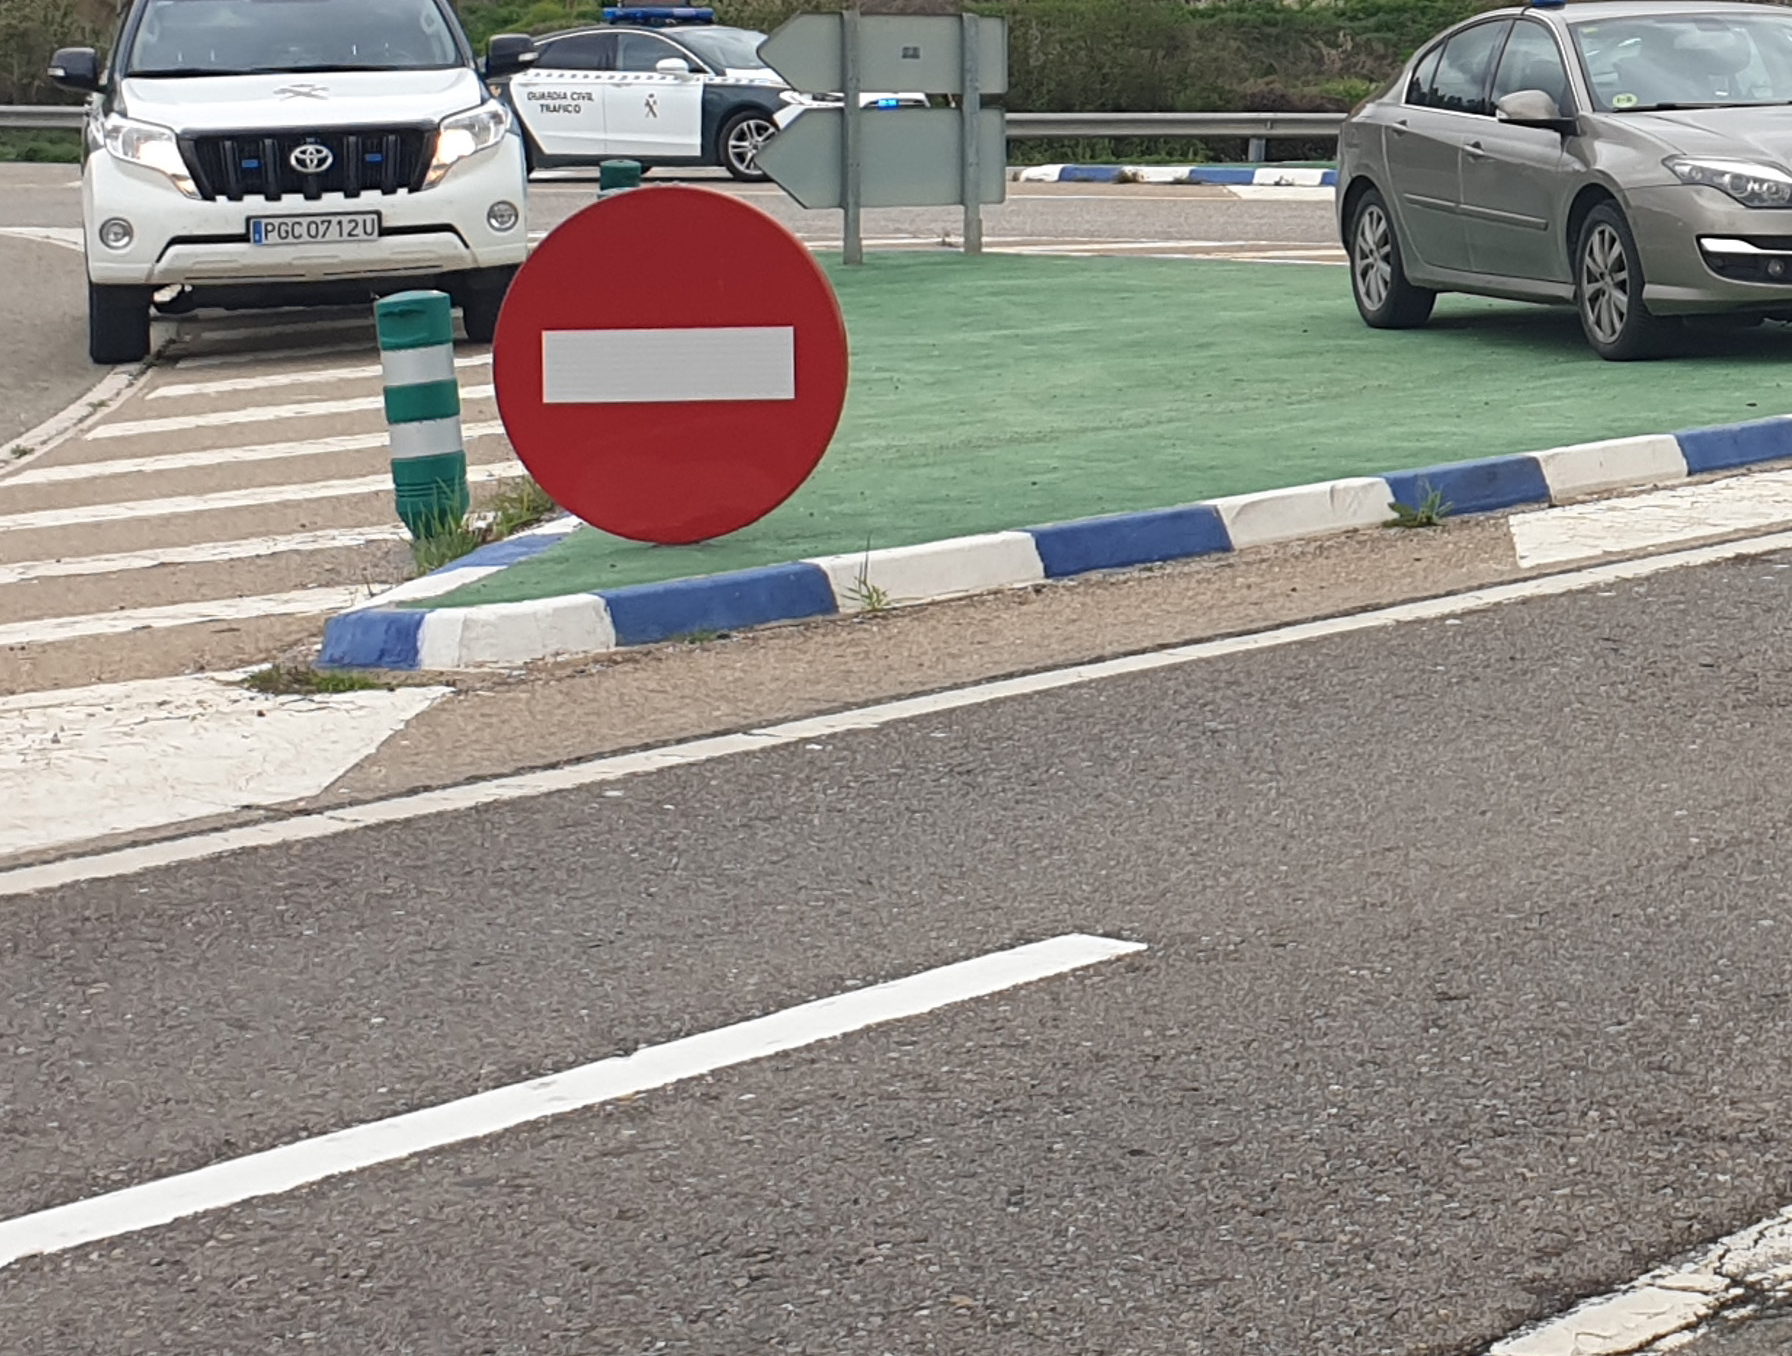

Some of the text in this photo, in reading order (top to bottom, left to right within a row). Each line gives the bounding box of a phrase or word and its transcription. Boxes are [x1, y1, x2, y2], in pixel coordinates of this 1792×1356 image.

[526, 91, 594, 102] GUARDIA CIVIL
[539, 104, 581, 114] TRAFICO
